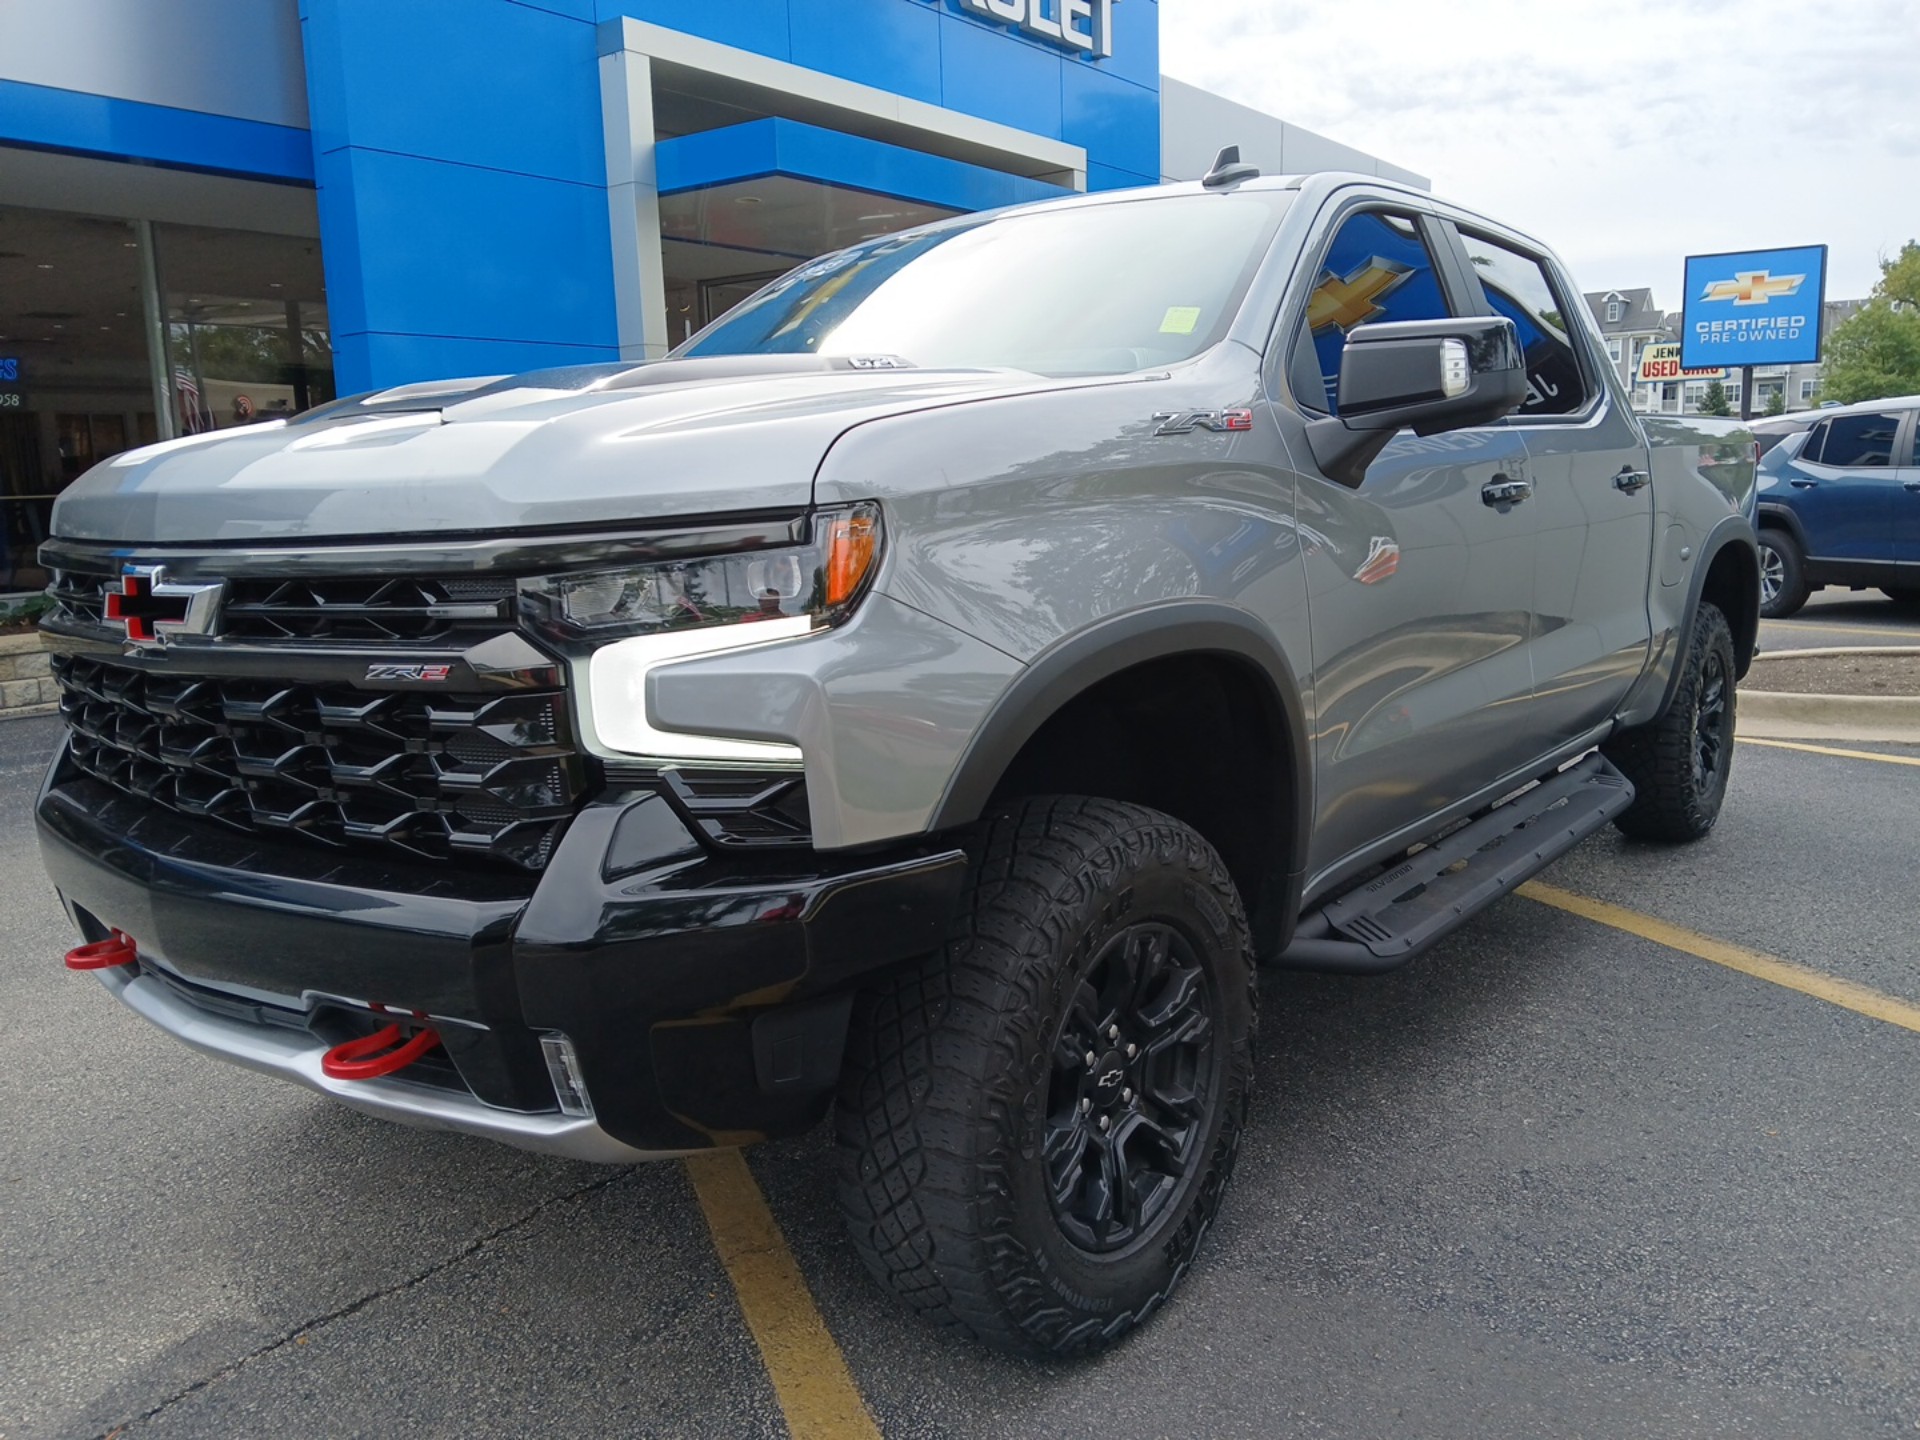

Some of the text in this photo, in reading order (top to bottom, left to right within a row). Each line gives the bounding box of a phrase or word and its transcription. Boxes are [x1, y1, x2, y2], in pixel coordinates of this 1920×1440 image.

[1696, 315, 1806, 333] CERTIFIED
[1700, 328, 1800, 344] PRE-OWNED
[1642, 360, 1678, 378] USED
[1152, 408, 1253, 436] ZR2
[365, 664, 451, 681] ZR2
